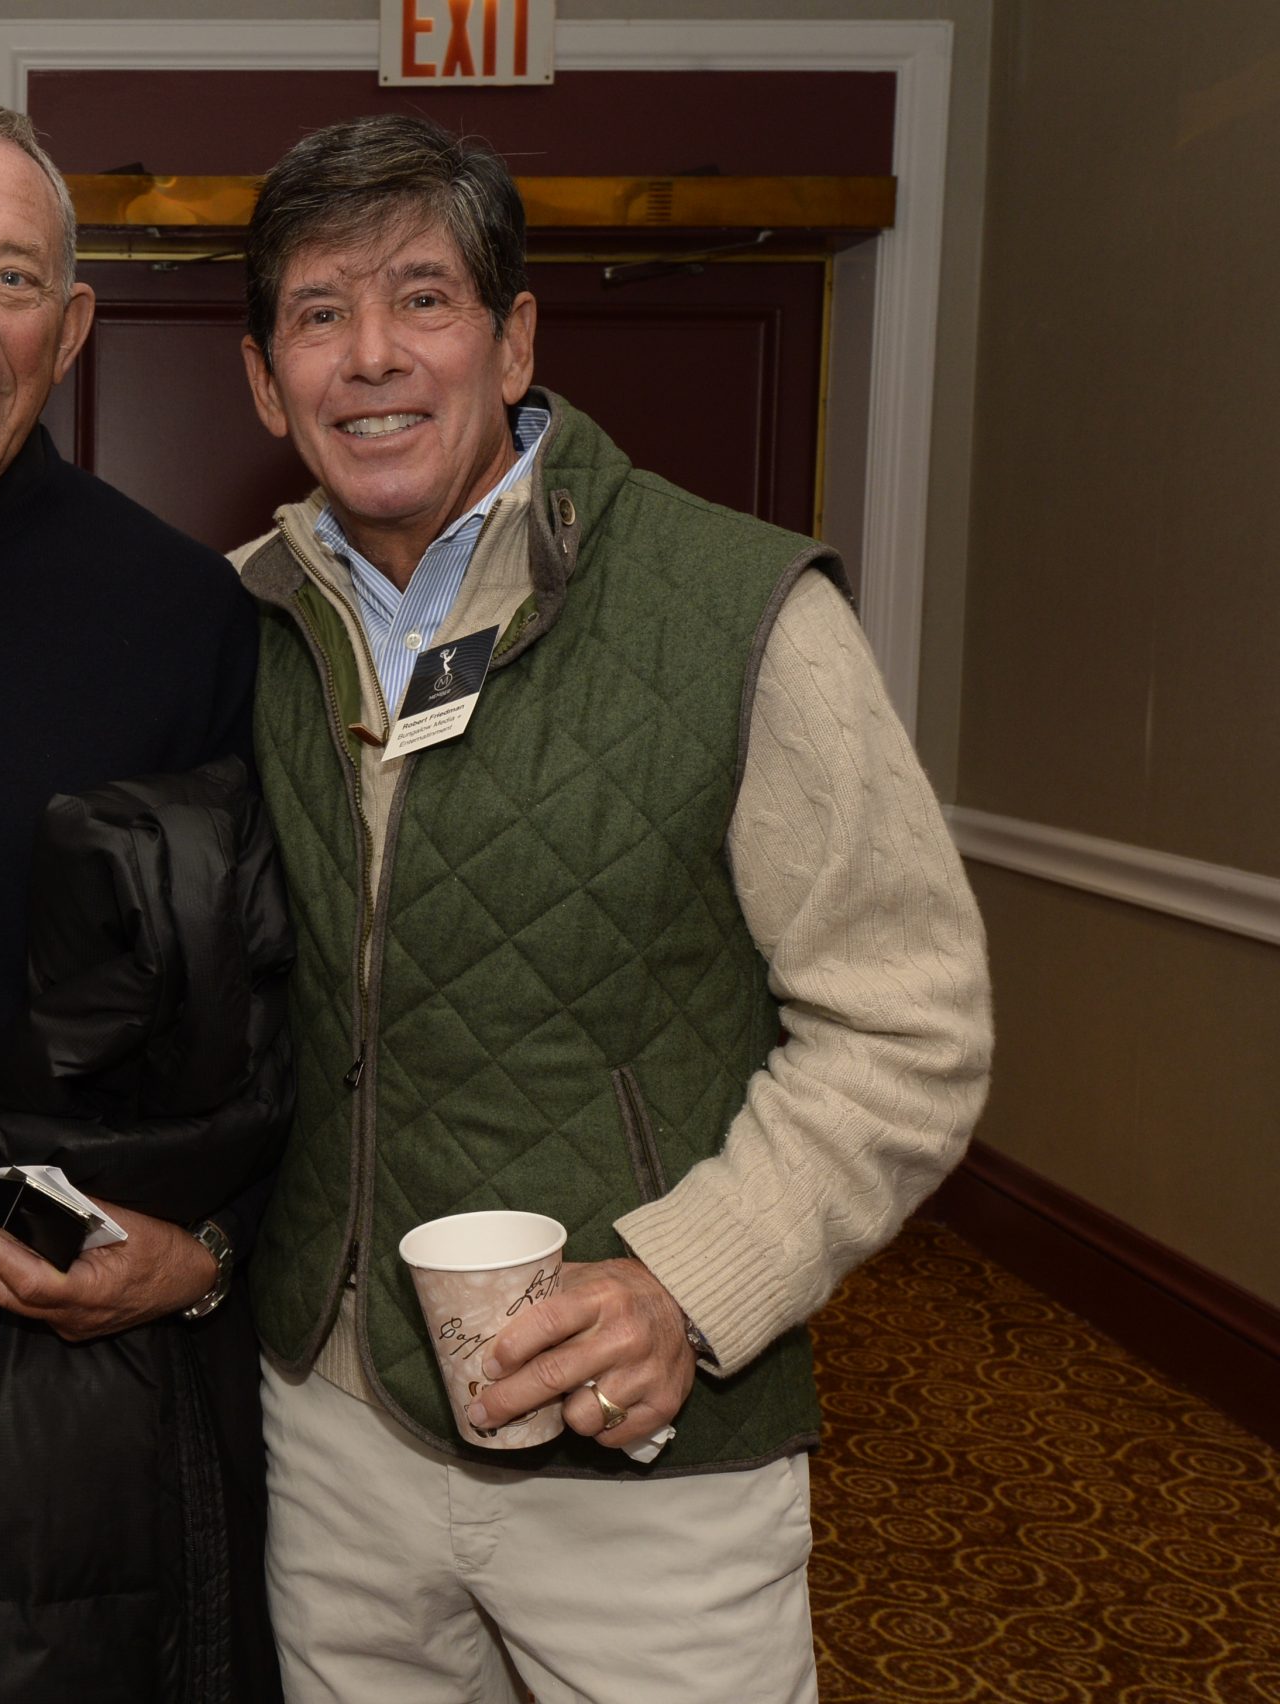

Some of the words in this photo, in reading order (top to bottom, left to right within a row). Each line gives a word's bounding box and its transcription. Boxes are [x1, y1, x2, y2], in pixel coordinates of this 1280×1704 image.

[401, 0, 528, 77] EXIT
[402, 716, 428, 730] Robert
[429, 704, 465, 721] Friedman
[433, 715, 456, 728] Media
